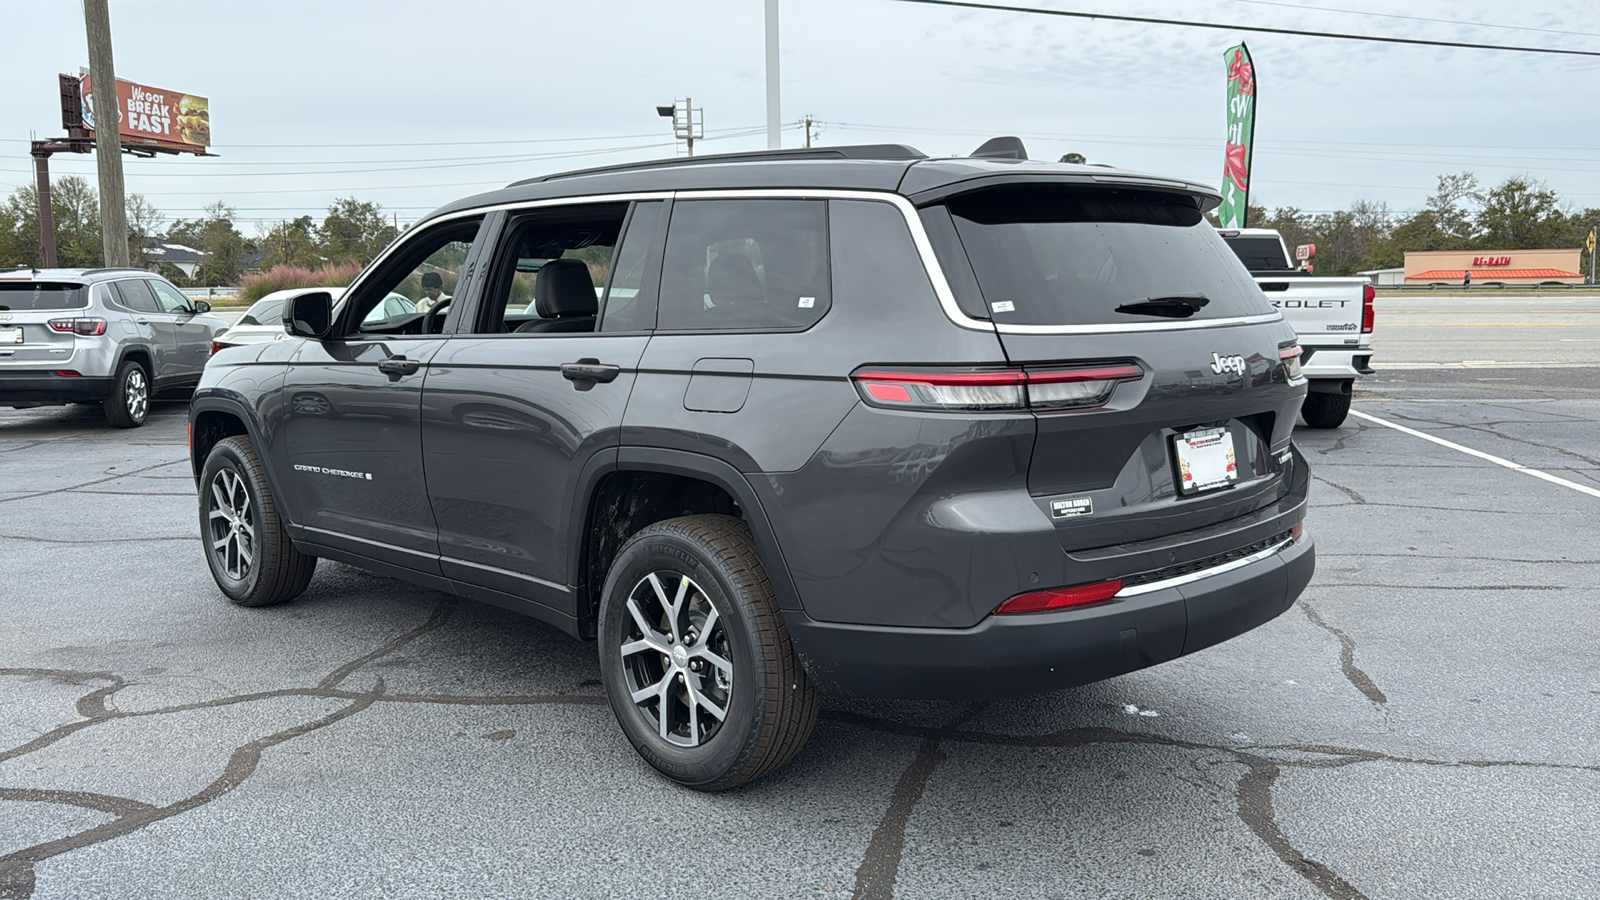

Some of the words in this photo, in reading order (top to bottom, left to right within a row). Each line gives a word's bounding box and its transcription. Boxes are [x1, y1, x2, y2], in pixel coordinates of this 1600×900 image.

[131, 85, 145, 101] We
[145, 91, 164, 104] GOT
[127, 98, 170, 118] BREAK
[127, 112, 171, 135] FAST
[1270, 300, 1350, 308] ROLET
[1210, 352, 1246, 376] Jeep
[294, 464, 320, 473] GRAND
[321, 467, 364, 479] CHEROKEE
[653, 545, 697, 568] MICHELIN
